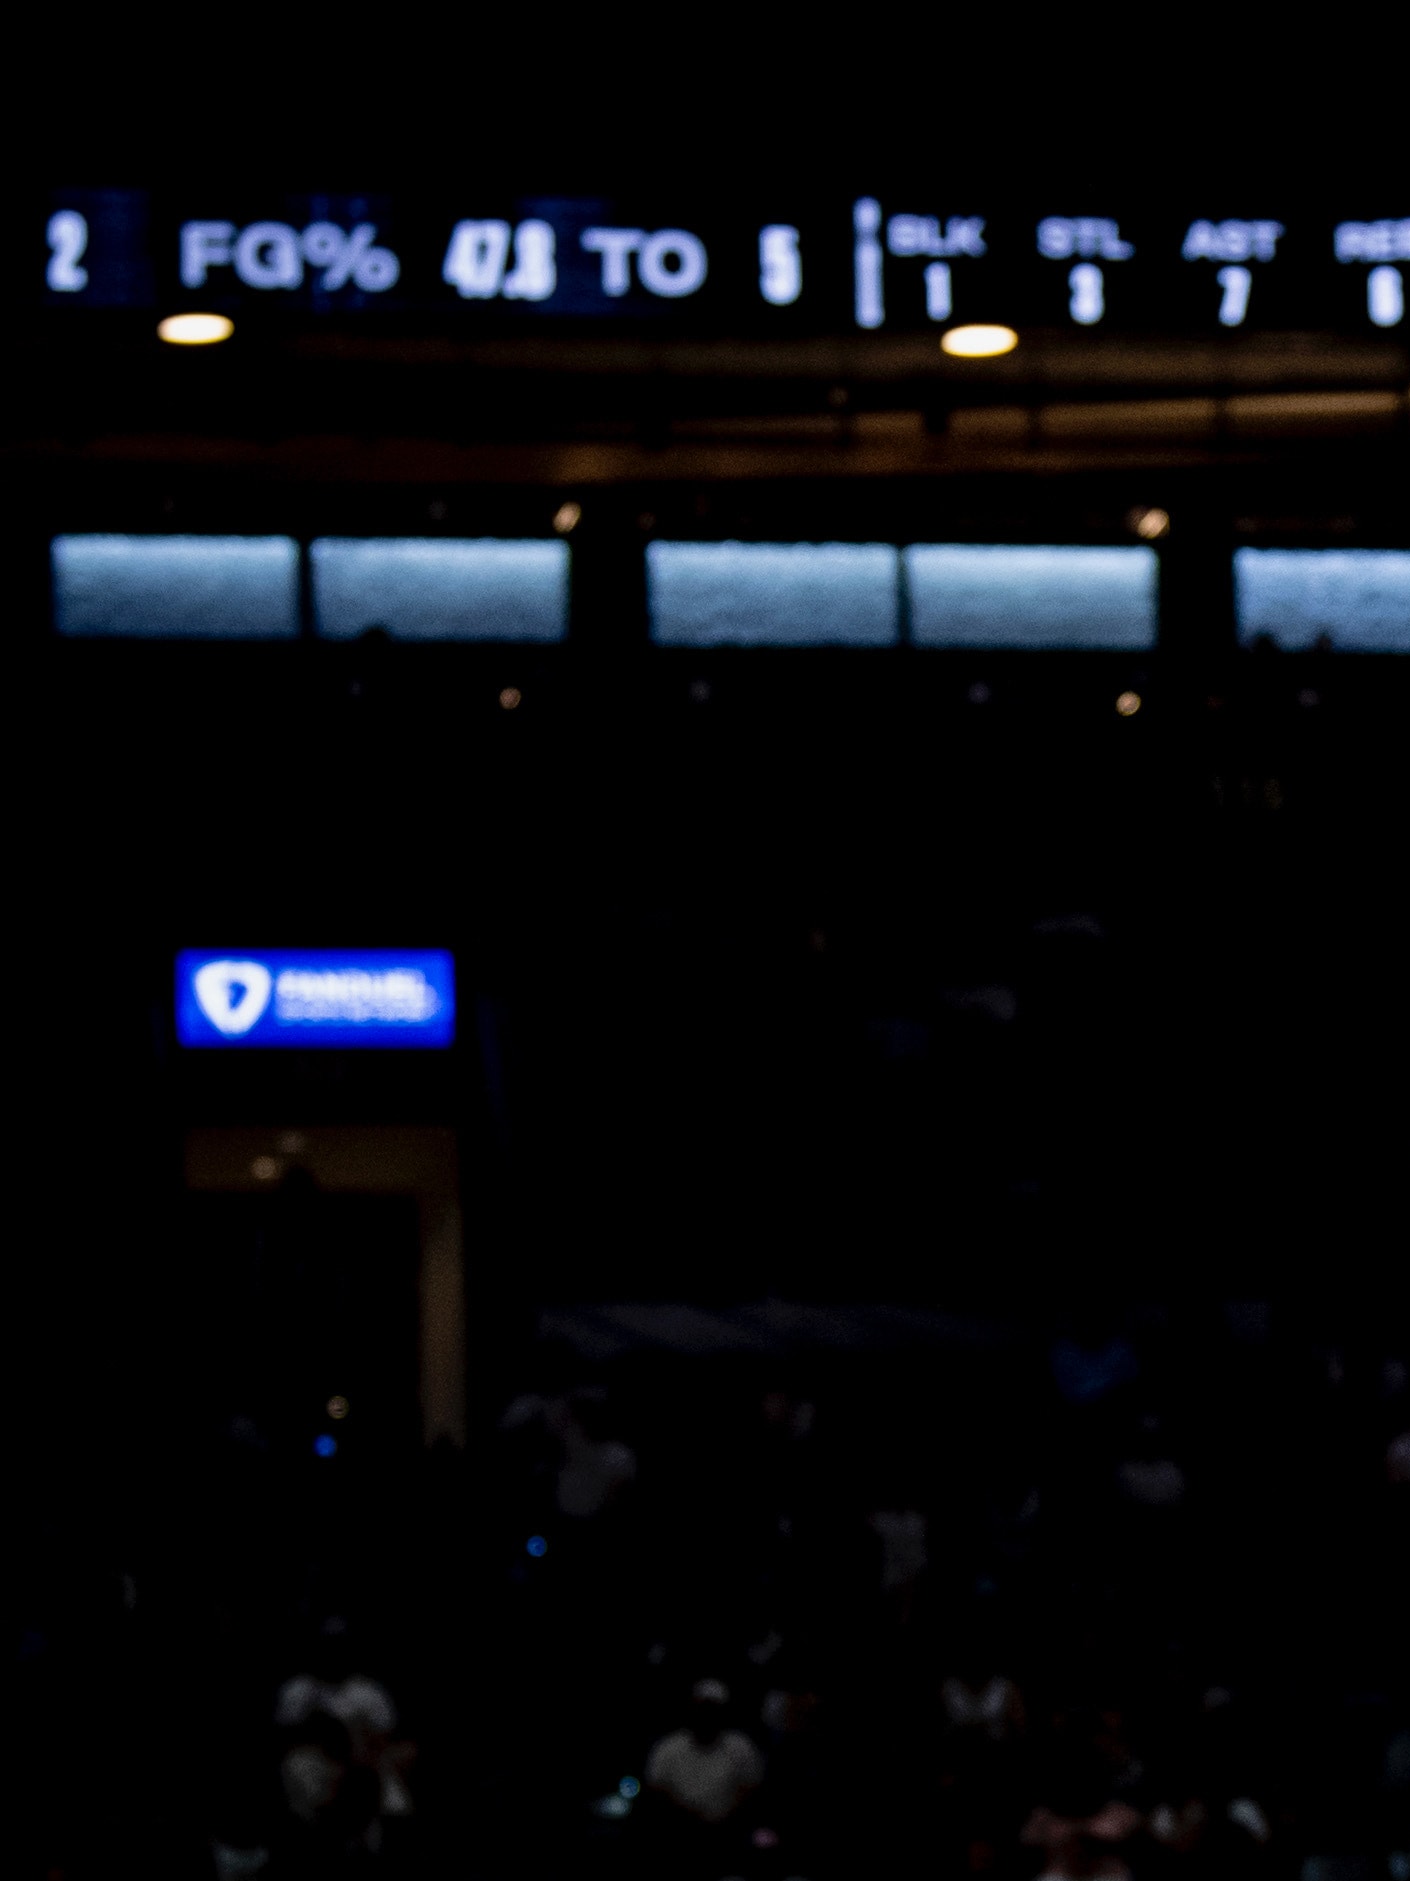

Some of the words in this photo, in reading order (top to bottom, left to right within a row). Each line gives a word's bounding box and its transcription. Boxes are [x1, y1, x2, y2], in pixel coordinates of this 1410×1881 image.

[181, 222, 399, 291] FG%
[582, 228, 707, 297] TO
[888, 214, 986, 257] BLK
[1038, 217, 1133, 262] STL
[1182, 219, 1284, 261] AST
[925, 262, 952, 322] 1
[1217, 265, 1252, 326] 7
